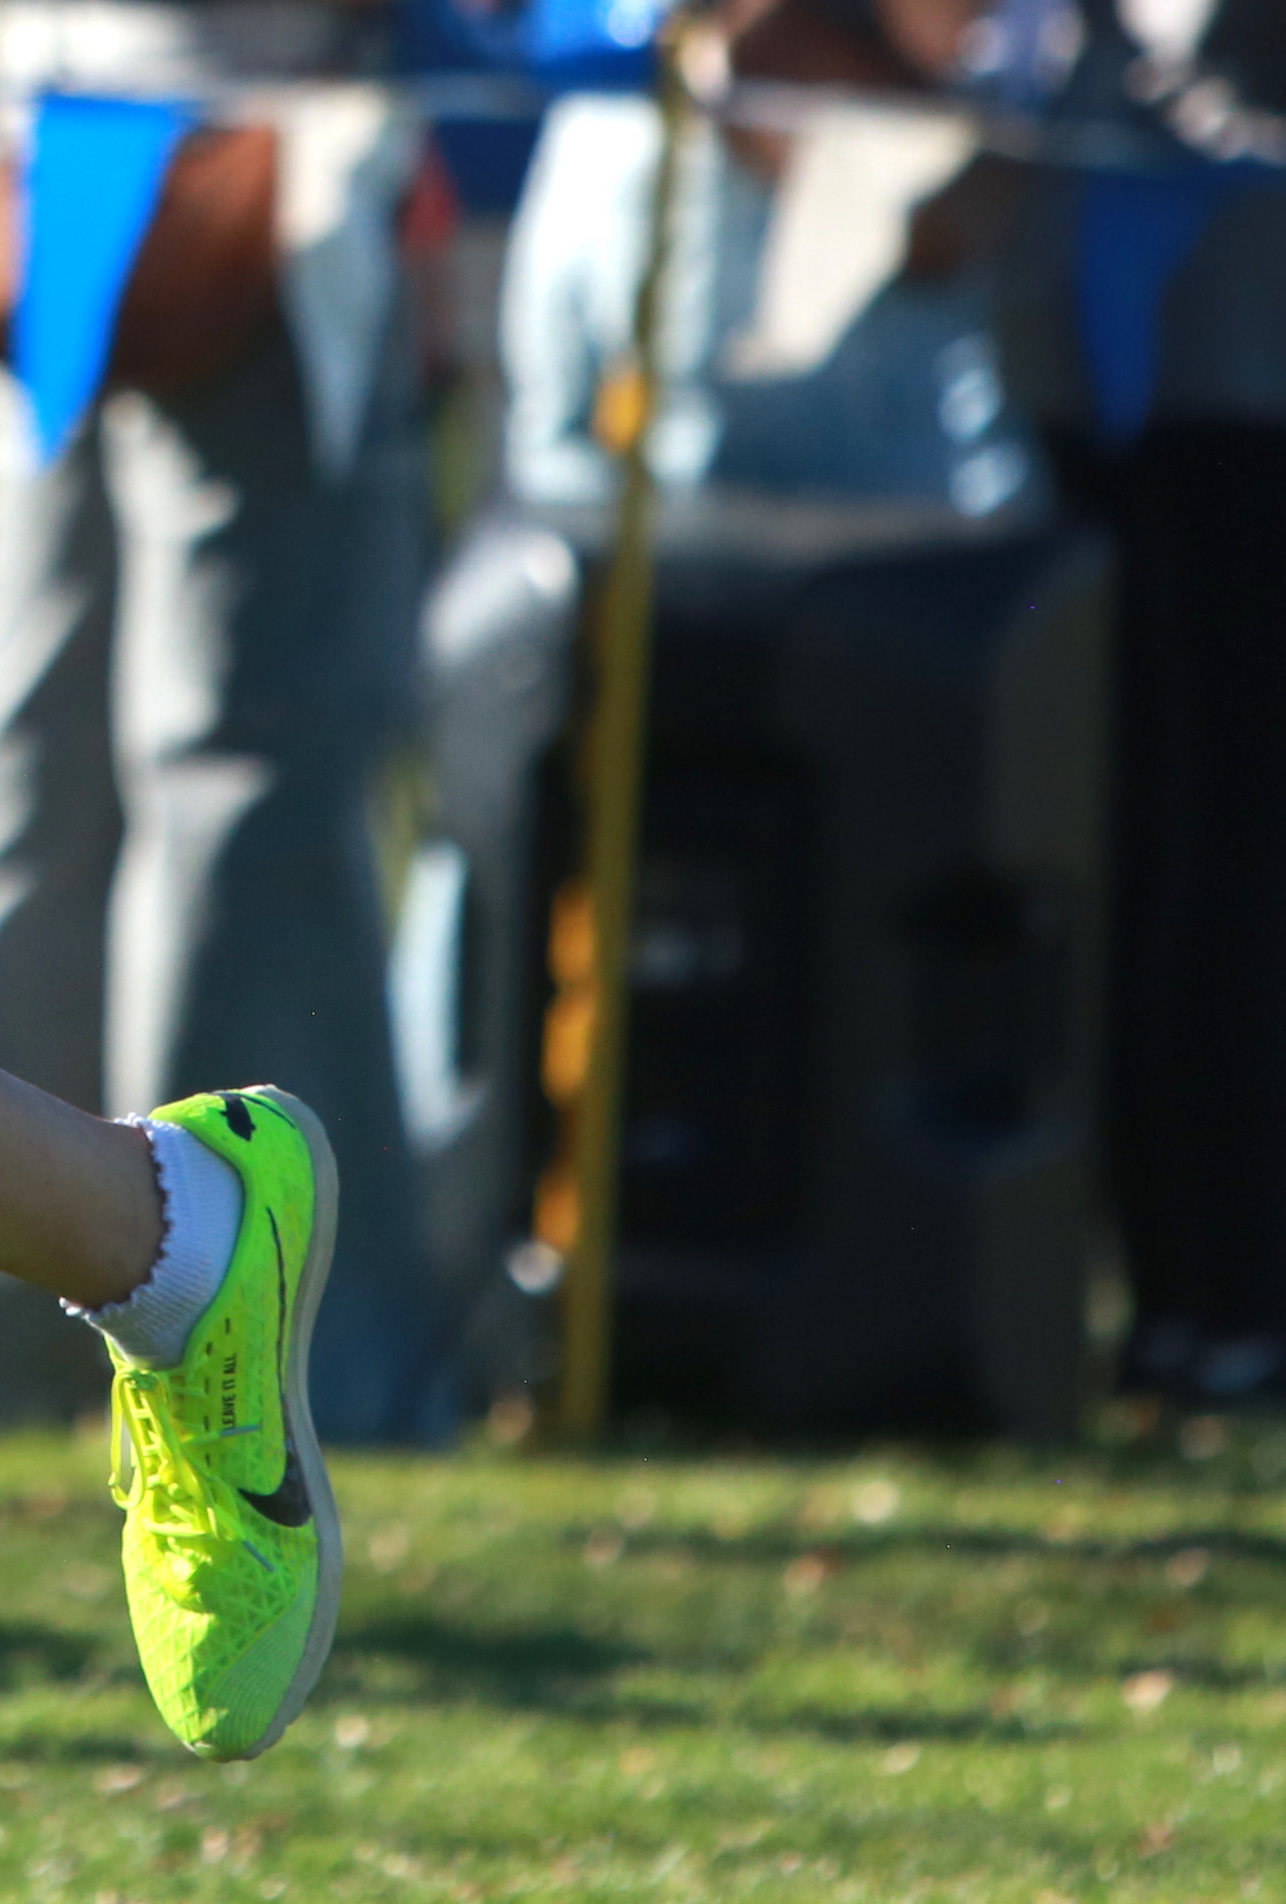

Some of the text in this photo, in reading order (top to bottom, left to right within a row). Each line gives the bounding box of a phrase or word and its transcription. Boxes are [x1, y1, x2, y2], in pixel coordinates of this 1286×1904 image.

[222, 1353, 237, 1431] LEAVE IT ALL
